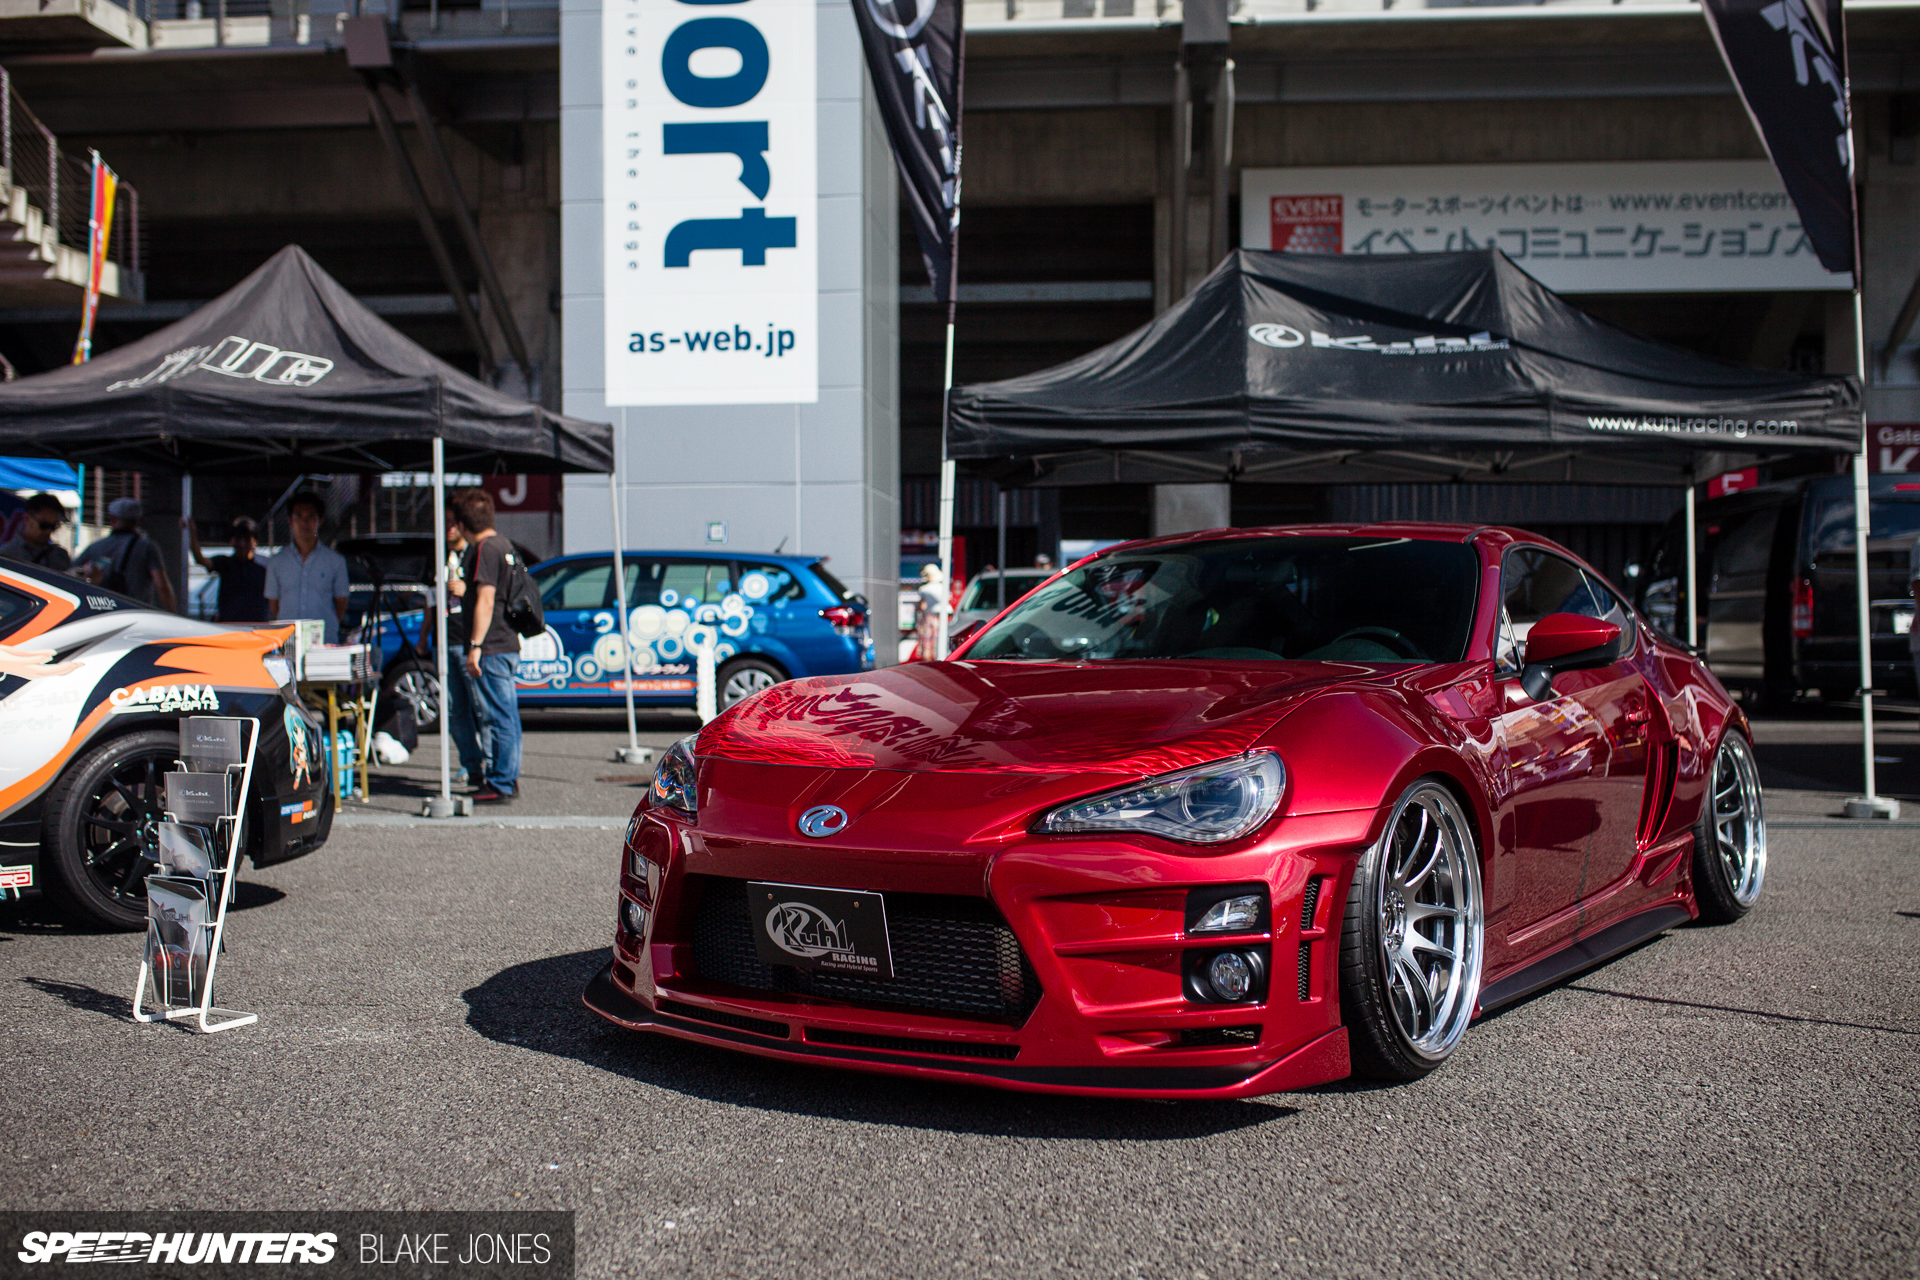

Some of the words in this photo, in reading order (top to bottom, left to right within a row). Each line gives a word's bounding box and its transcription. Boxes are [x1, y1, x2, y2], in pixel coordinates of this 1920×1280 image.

[626, 0, 641, 56] ive
[626, 78, 639, 109] on
[661, 0, 797, 268] ort
[626, 130, 641, 178] the
[624, 200, 642, 271] edge
[628, 323, 796, 357] as-web.jp
[1587, 415, 1798, 439] www.kuhl-racing.com
[109, 684, 218, 707] CABANA
[159, 700, 220, 713] SPORTS
[821, 960, 837, 969] Racing
[847, 963, 863, 972] Hybrid
[863, 965, 878, 973] Sports
[832, 953, 878, 966] RACING
